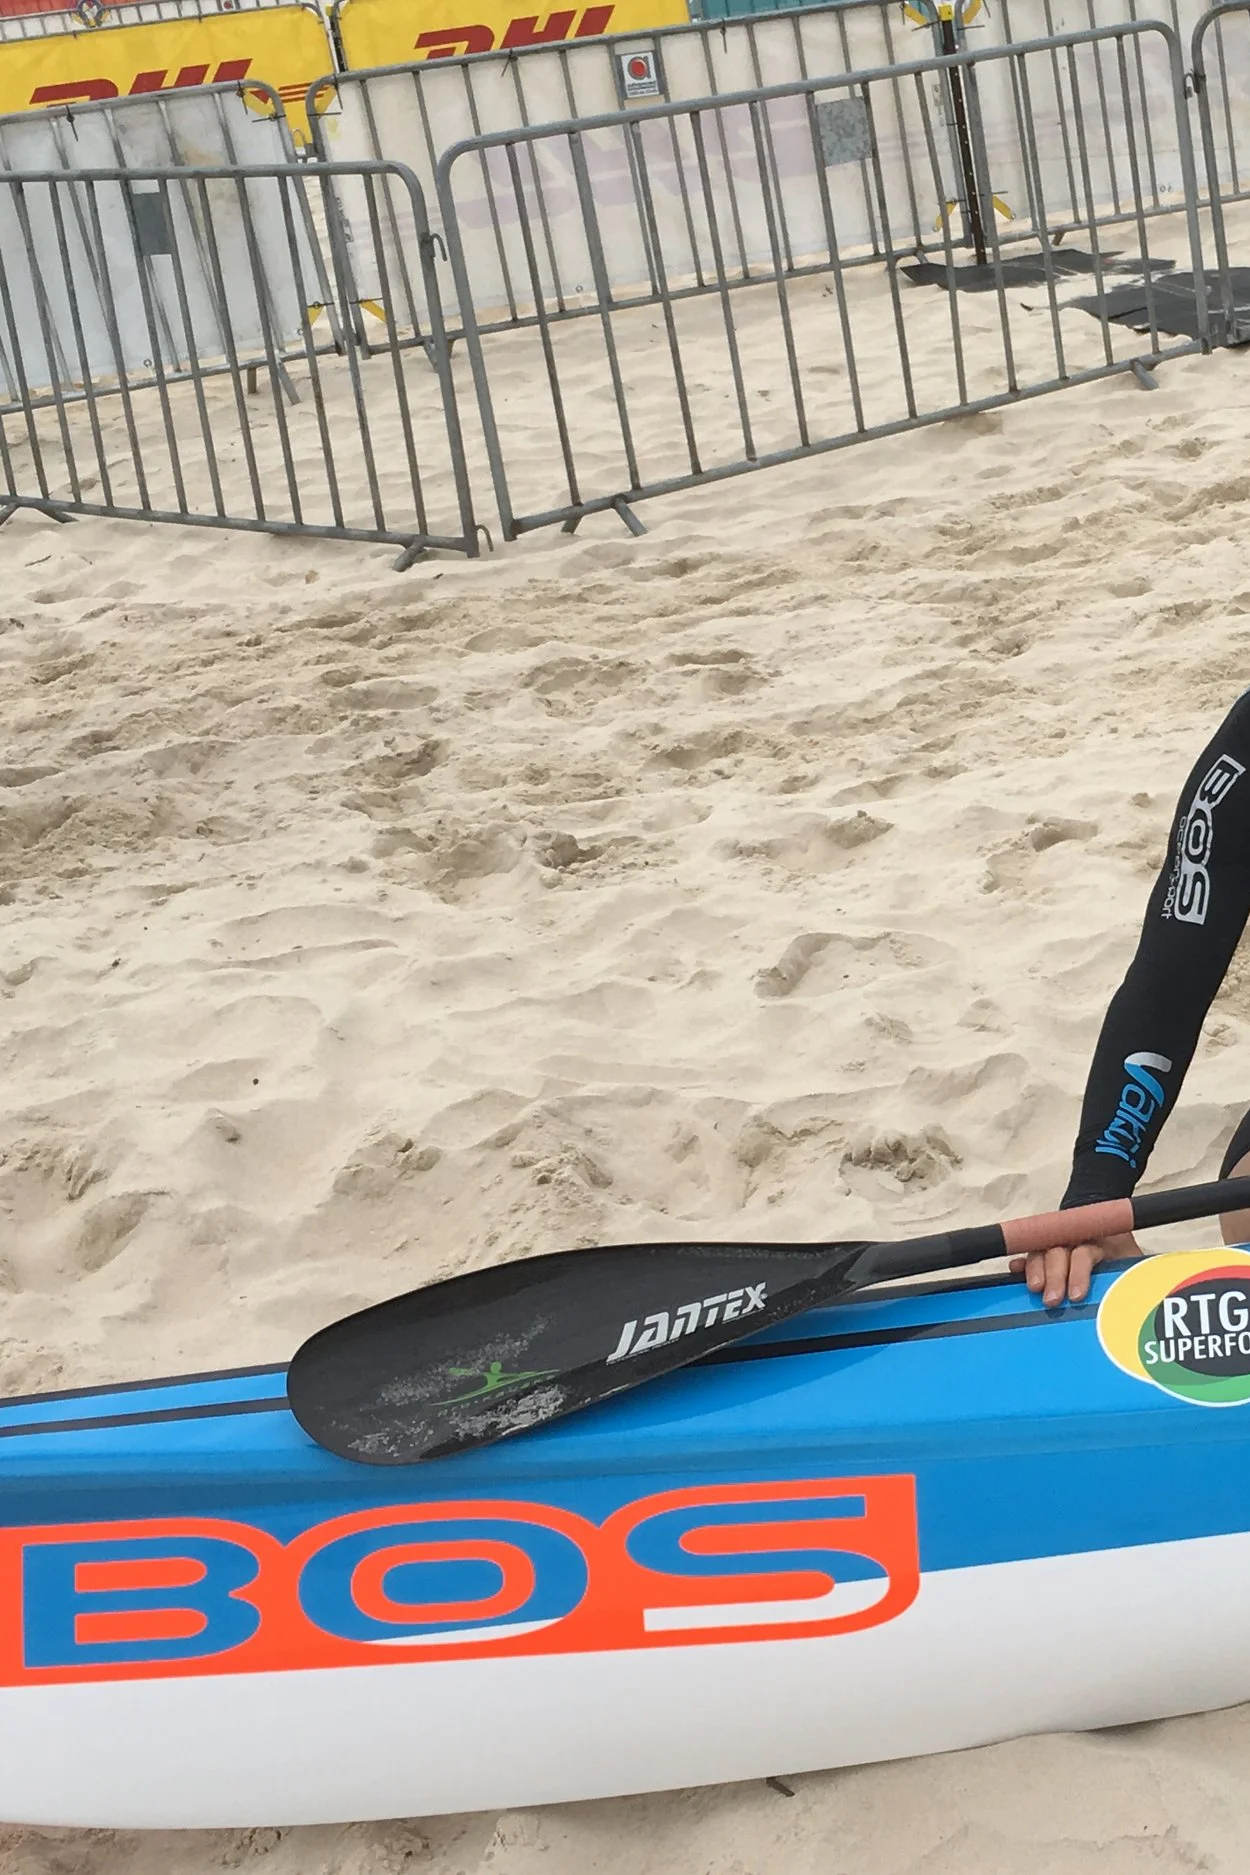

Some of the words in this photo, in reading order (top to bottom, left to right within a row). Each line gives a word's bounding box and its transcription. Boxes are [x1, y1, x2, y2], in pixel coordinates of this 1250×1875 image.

[412, 5, 615, 59] DHL
[1176, 756, 1243, 920] BOS
[1163, 1291, 1249, 1338] RTG
[15, 1490, 896, 1672] BOS
